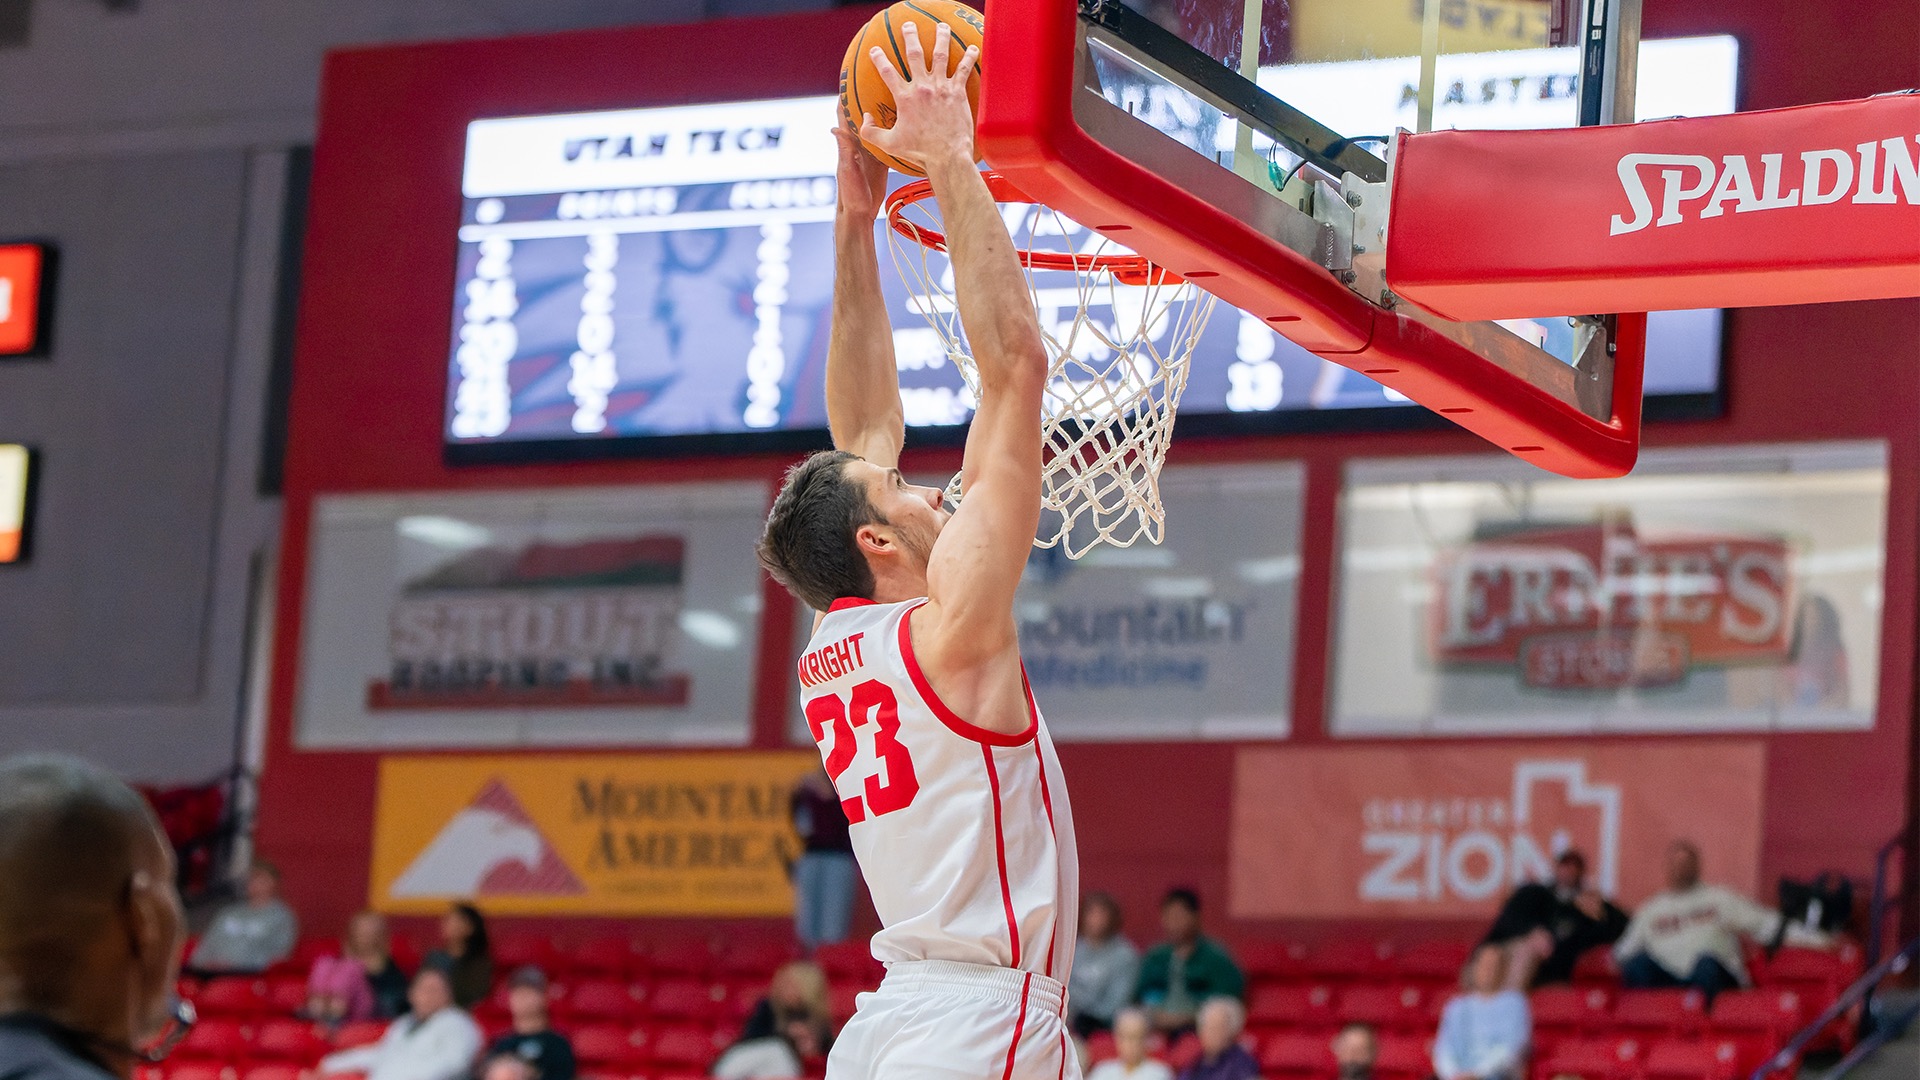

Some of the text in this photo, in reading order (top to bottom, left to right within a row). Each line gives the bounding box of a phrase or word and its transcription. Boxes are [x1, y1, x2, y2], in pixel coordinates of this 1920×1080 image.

[563, 126, 785, 162] UTAH TECH
[1438, 547, 1784, 648] ERNIE'S
[390, 600, 674, 657] STOUT
[798, 632, 864, 688] WRIGHT
[805, 678, 920, 826] 23
